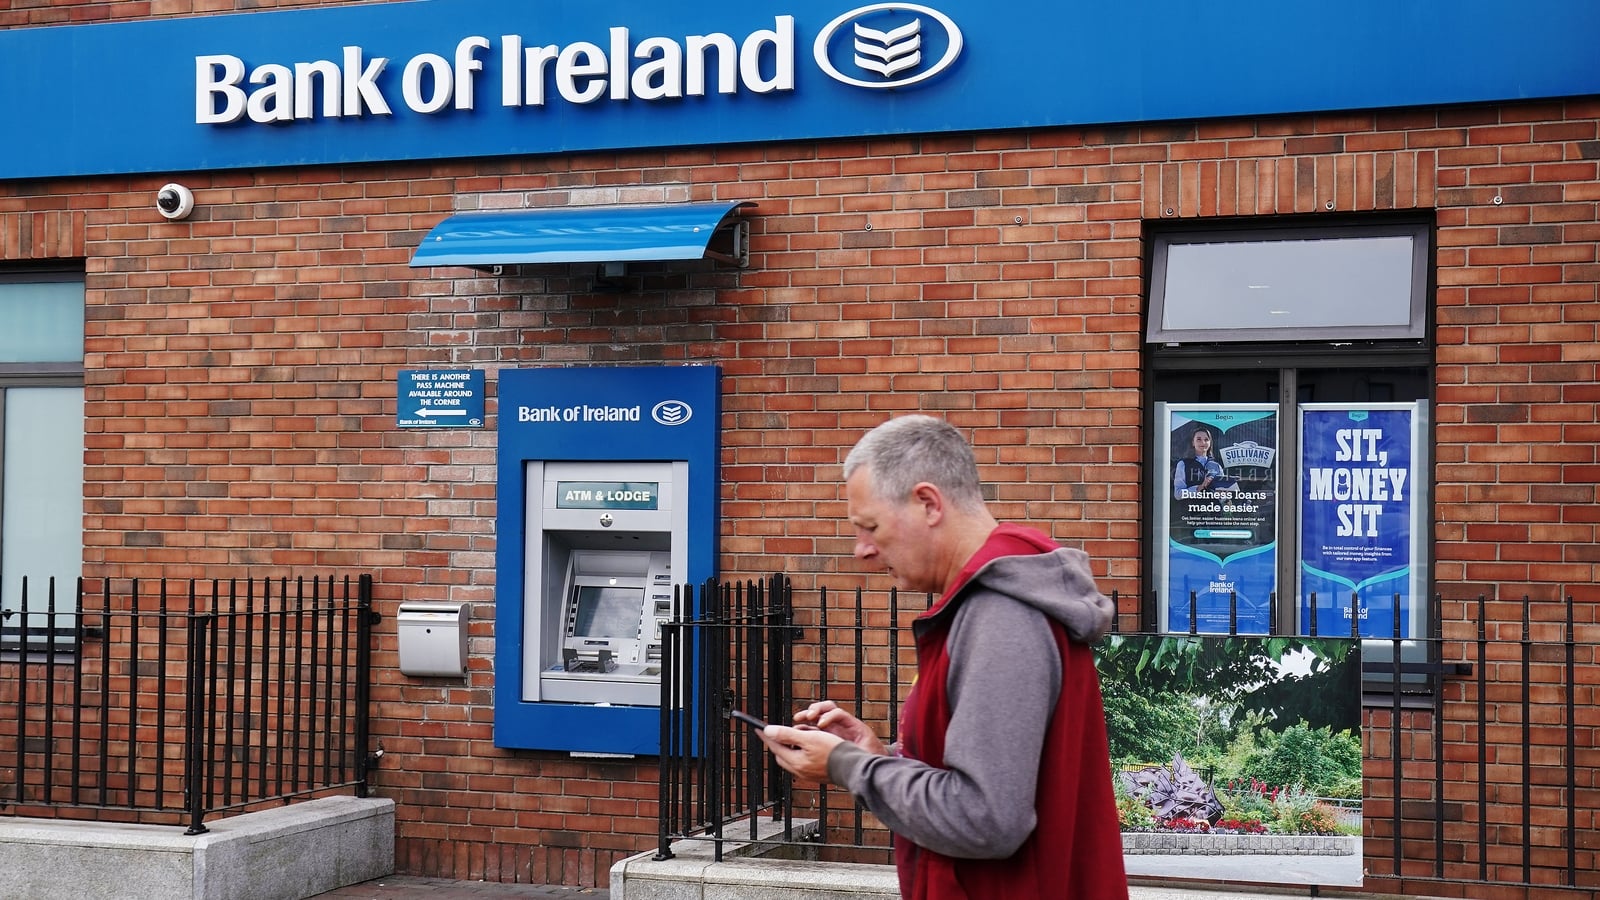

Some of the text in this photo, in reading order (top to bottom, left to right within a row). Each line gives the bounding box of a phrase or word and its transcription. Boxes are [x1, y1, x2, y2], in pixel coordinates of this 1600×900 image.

[196, 15, 794, 124] Bank of Ireland
[518, 405, 640, 422] Bank of Ireland
[1225, 449, 1270, 460] SULLIVANS
[1335, 428, 1388, 467] SIT,
[1309, 468, 1407, 501] MONEY
[565, 490, 651, 501] ATM & LODGE
[1181, 489, 1267, 500] Business loans
[1188, 502, 1259, 513] made easier
[1336, 504, 1383, 537] SIT
